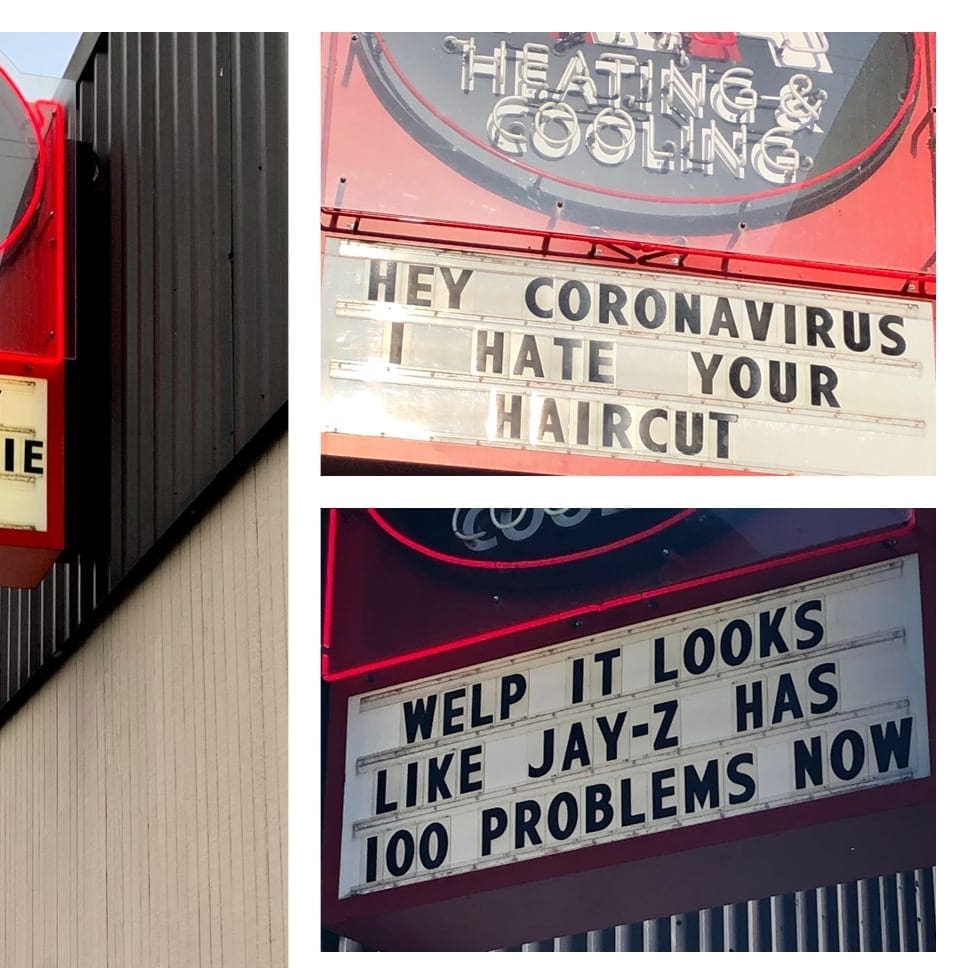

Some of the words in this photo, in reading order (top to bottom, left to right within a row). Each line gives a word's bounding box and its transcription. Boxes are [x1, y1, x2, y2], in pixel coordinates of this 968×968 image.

[460, 37, 758, 124] HEATING
[775, 73, 826, 134] &
[488, 96, 800, 184] COOLING
[368, 259, 473, 310] HEY
[525, 277, 906, 357] CORONAVIRUS
[389, 322, 403, 364] I
[476, 330, 615, 384] HATE
[692, 351, 840, 408] YOUR
[495, 393, 736, 459] HAIRCUT
[403, 673, 527, 744] WELP
[571, 648, 621, 704] IT
[654, 600, 824, 683] LOOKS
[376, 745, 483, 814] LIKE
[529, 699, 679, 778] JAY-Z
[735, 662, 839, 732] HAS
[365, 821, 448, 883] 100
[481, 752, 756, 855] PROBLEMS
[793, 717, 913, 790] NOW
